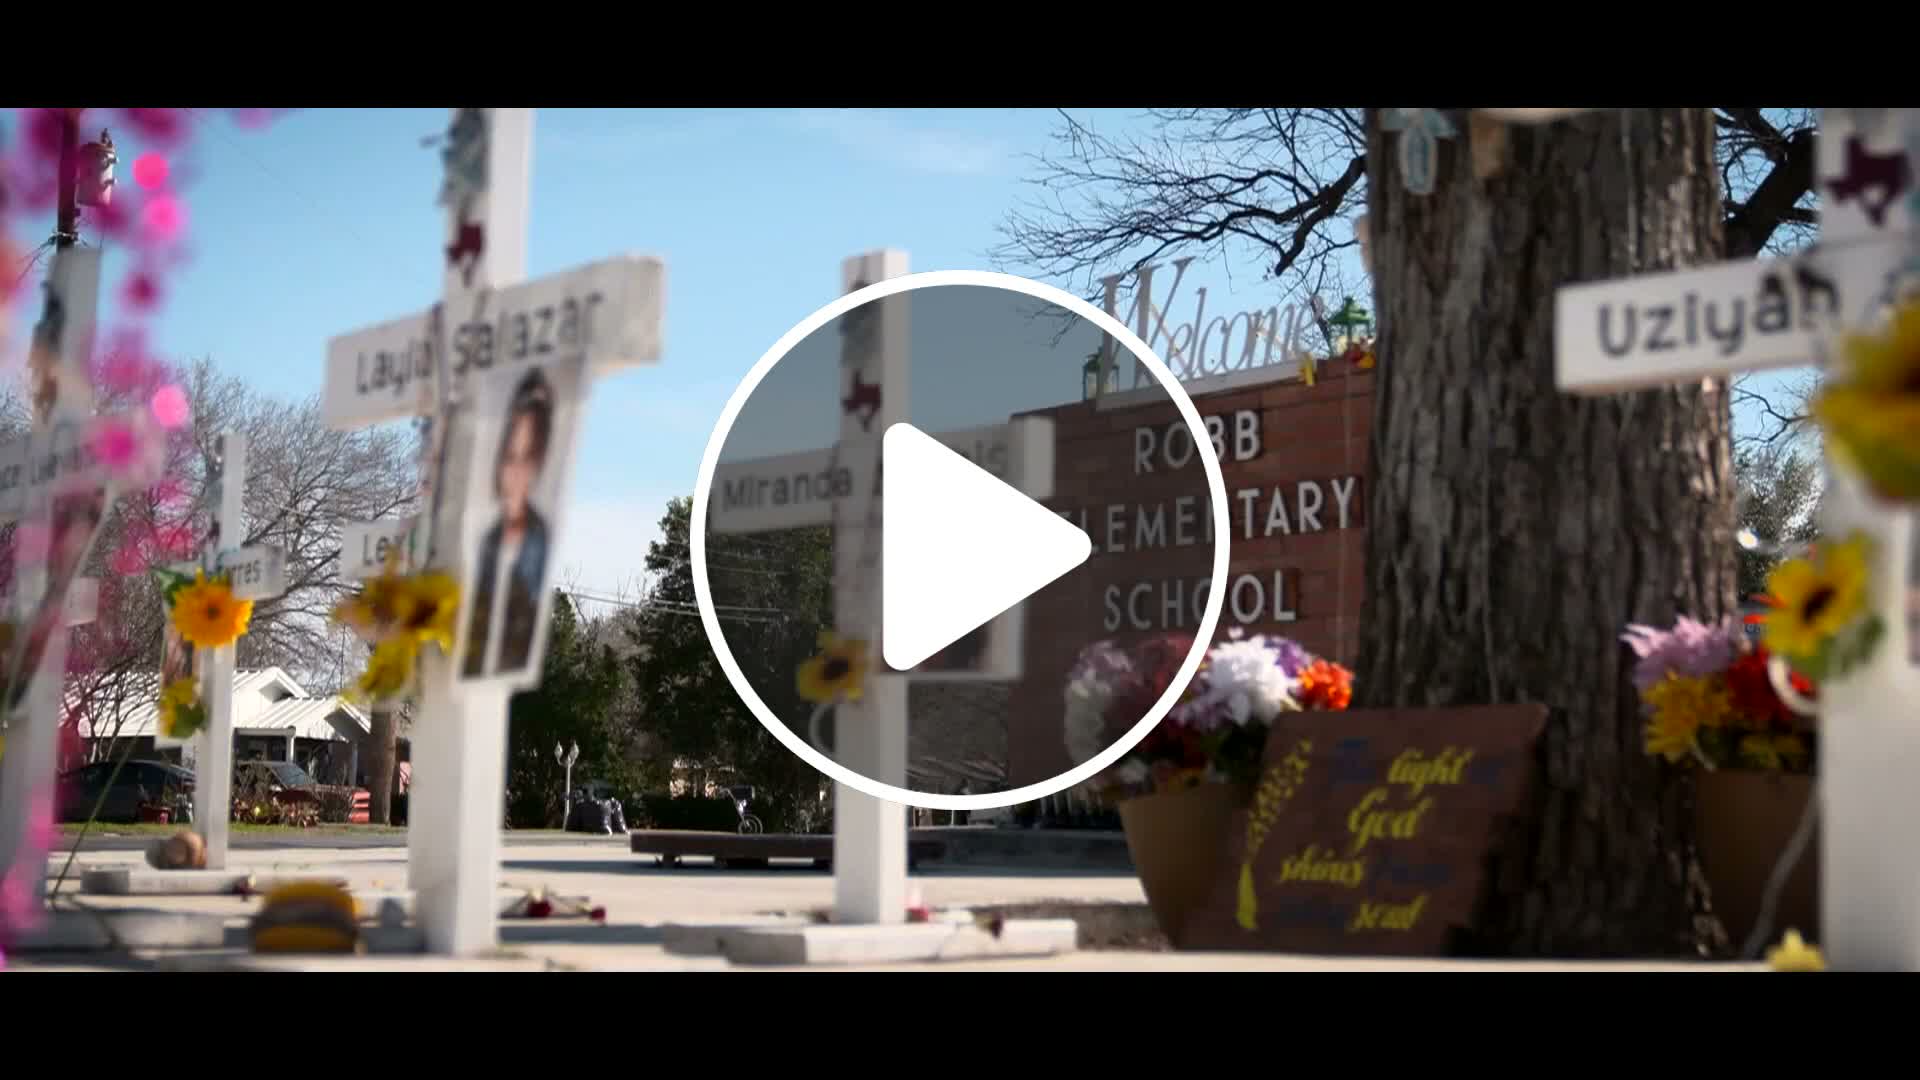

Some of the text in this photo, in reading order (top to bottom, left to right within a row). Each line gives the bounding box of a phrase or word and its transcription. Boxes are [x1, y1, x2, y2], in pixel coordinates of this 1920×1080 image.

[1096, 256, 1324, 390] Welcome
[1135, 410, 1262, 475] ROBB
[722, 461, 852, 511] Miranda
[1060, 477, 1356, 556] LEMETARY
[1104, 569, 1296, 632] SCHOOL
[1387, 746, 1474, 797] light
[1348, 786, 1433, 857] God
